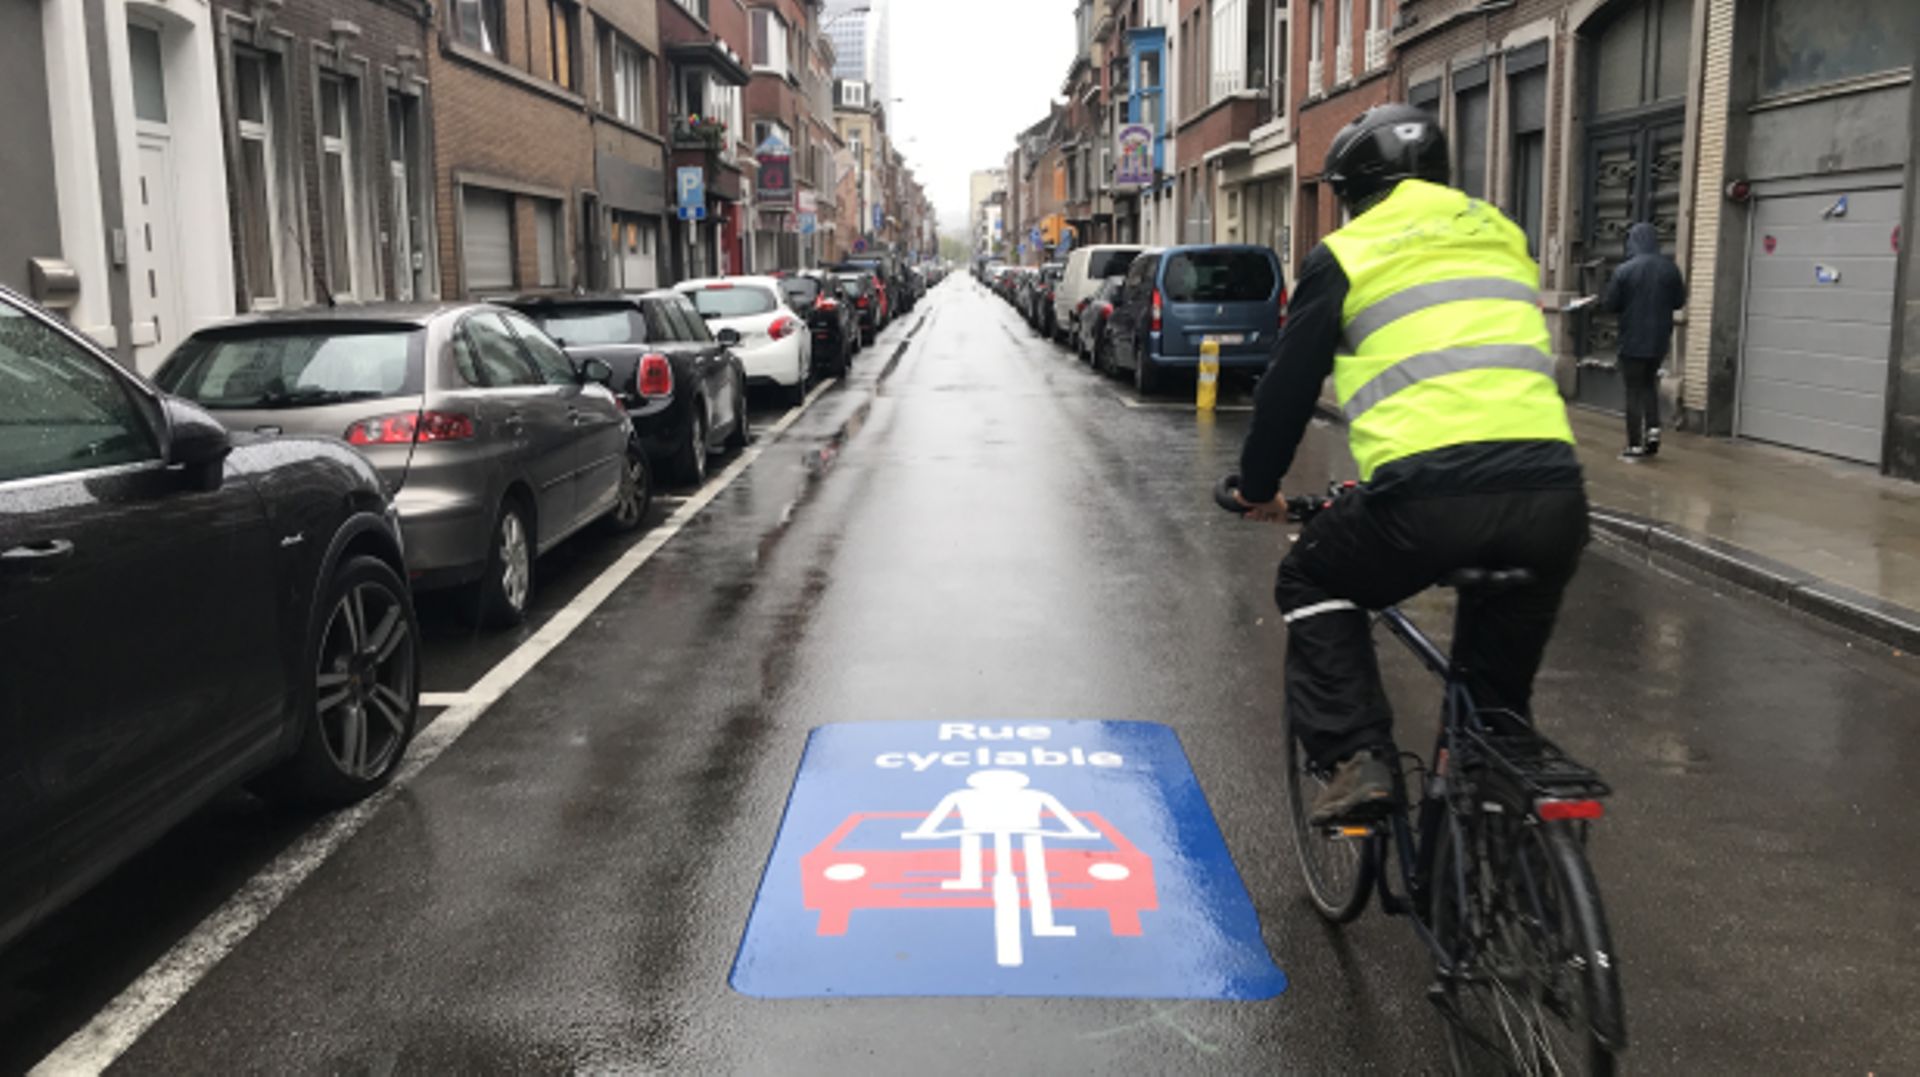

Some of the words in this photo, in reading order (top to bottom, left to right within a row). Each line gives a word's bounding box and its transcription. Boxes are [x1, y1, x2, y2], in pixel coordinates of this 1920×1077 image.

[682, 173, 698, 200] P
[939, 723, 1051, 740] Rue
[875, 747, 1123, 771] cyclable
